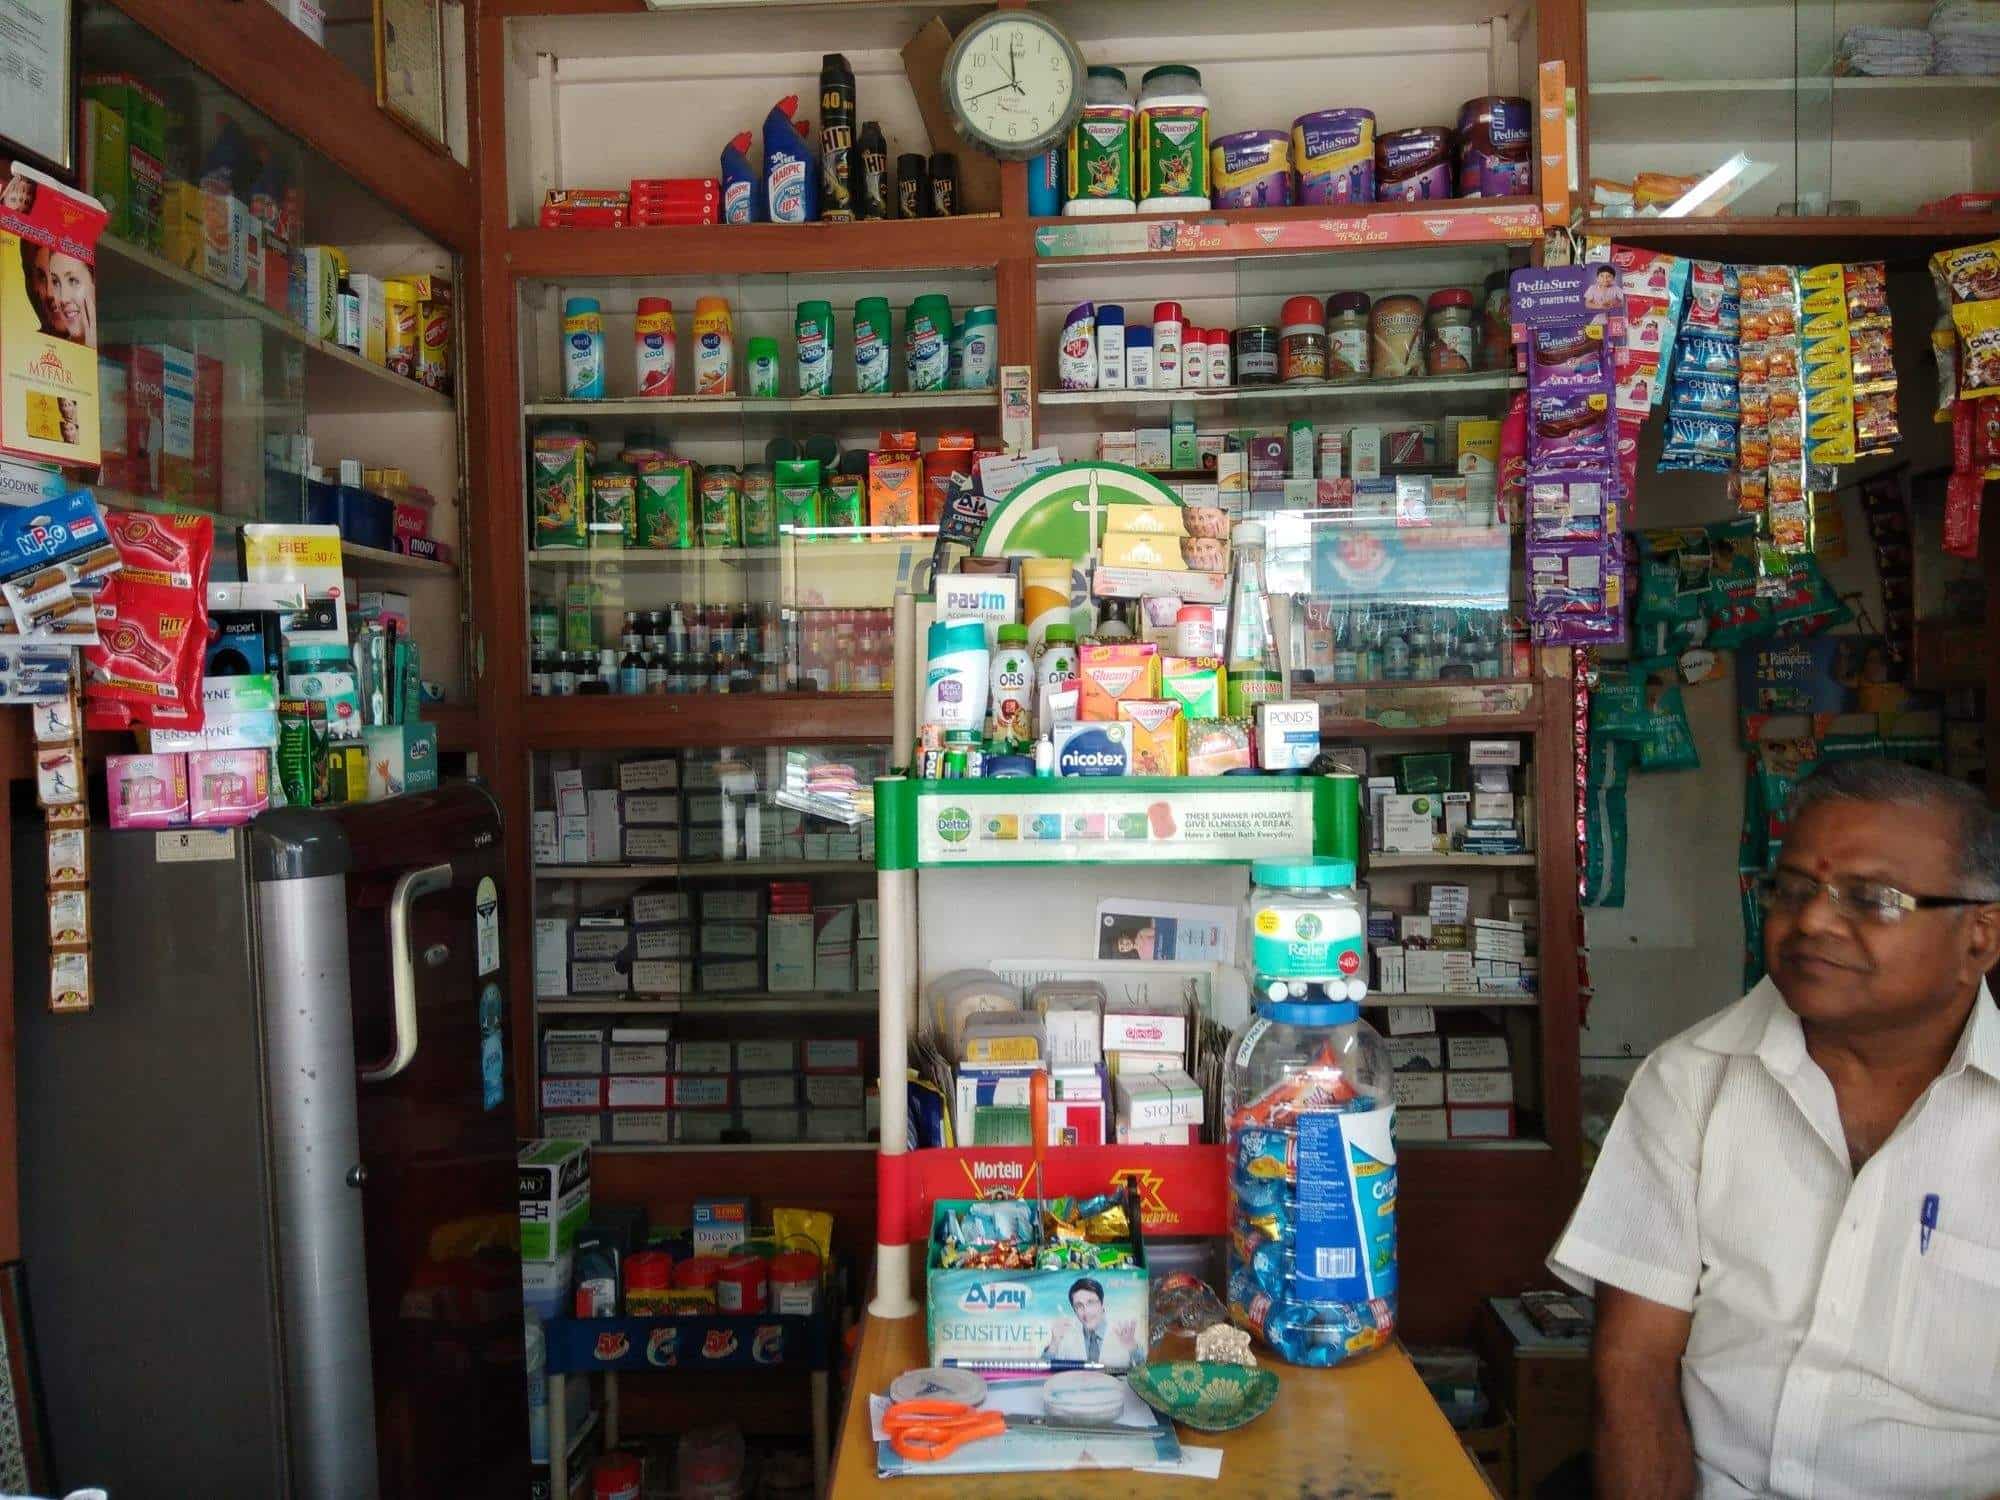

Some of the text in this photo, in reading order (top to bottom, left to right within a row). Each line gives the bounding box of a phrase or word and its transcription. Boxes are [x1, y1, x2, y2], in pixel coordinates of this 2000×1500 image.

[964, 75, 973, 89] 9
[1056, 80, 1065, 95] 3
[1048, 100, 1056, 117] 4
[986, 116, 994, 130] 7
[1008, 122, 1017, 136] 6
[1031, 118, 1040, 133] 5
[821, 127, 852, 152] HIT
[1307, 135, 1359, 155] PediaSure
[865, 154, 887, 174] HIT
[1516, 279, 1581, 294] PediaSure
[28, 361, 74, 385] MYFAIR
[175, 514, 199, 524] HIT
[16, 525, 67, 556] NIPPO
[947, 590, 1005, 611] paytm
[159, 618, 181, 634] HIT
[225, 621, 256, 634] expert
[999, 673, 1025, 687] ORS
[940, 706, 960, 718] ICE
[1061, 750, 1124, 767] nicotex
[1211, 812, 1249, 820] SUMMER
[938, 819, 971, 831] Dettol
[1184, 820, 1206, 828] GIVE
[1208, 820, 1252, 828] ILLNESSES
[1288, 943, 1330, 956] Relief
[973, 1161, 1024, 1180] Mortein
[966, 1279, 1026, 1310] Ajay
